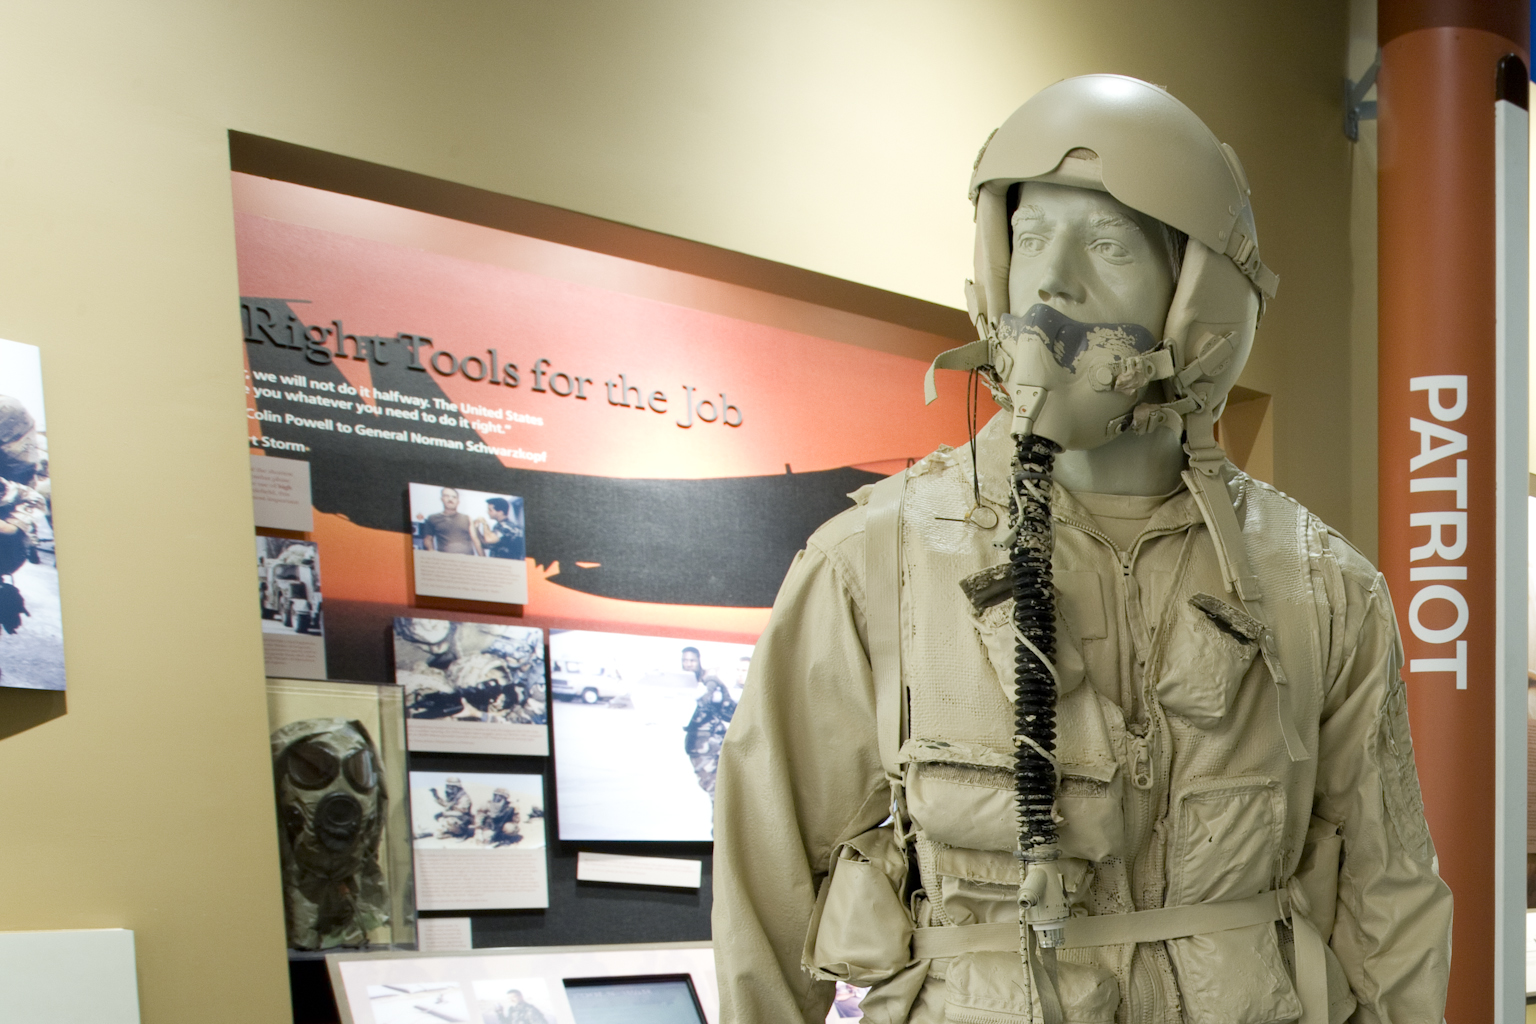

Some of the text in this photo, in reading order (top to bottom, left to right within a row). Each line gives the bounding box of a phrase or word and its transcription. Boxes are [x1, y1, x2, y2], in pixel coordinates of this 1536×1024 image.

[241, 304, 743, 429] Right Tools for the Job
[252, 370, 278, 383] we
[279, 374, 307, 388] will
[309, 379, 335, 393] not
[337, 382, 357, 395] do
[359, 385, 370, 398] it
[373, 387, 431, 409] halfway.
[432, 397, 458, 412] The
[460, 402, 503, 420] United
[505, 410, 544, 426] States
[253, 385, 282, 399] you
[284, 390, 353, 411] whatever
[355, 402, 382, 416] you
[385, 406, 419, 421] need
[421, 411, 437, 423] to
[439, 413, 457, 427] do
[459, 415, 470, 429] it
[285, 413, 334, 431] Powell
[336, 421, 352, 433] to
[355, 424, 408, 442] General
[411, 432, 464, 450] Norman
[466, 440, 547, 464] Schwarzkopf
[1408, 374, 1470, 690] PATRIOT
